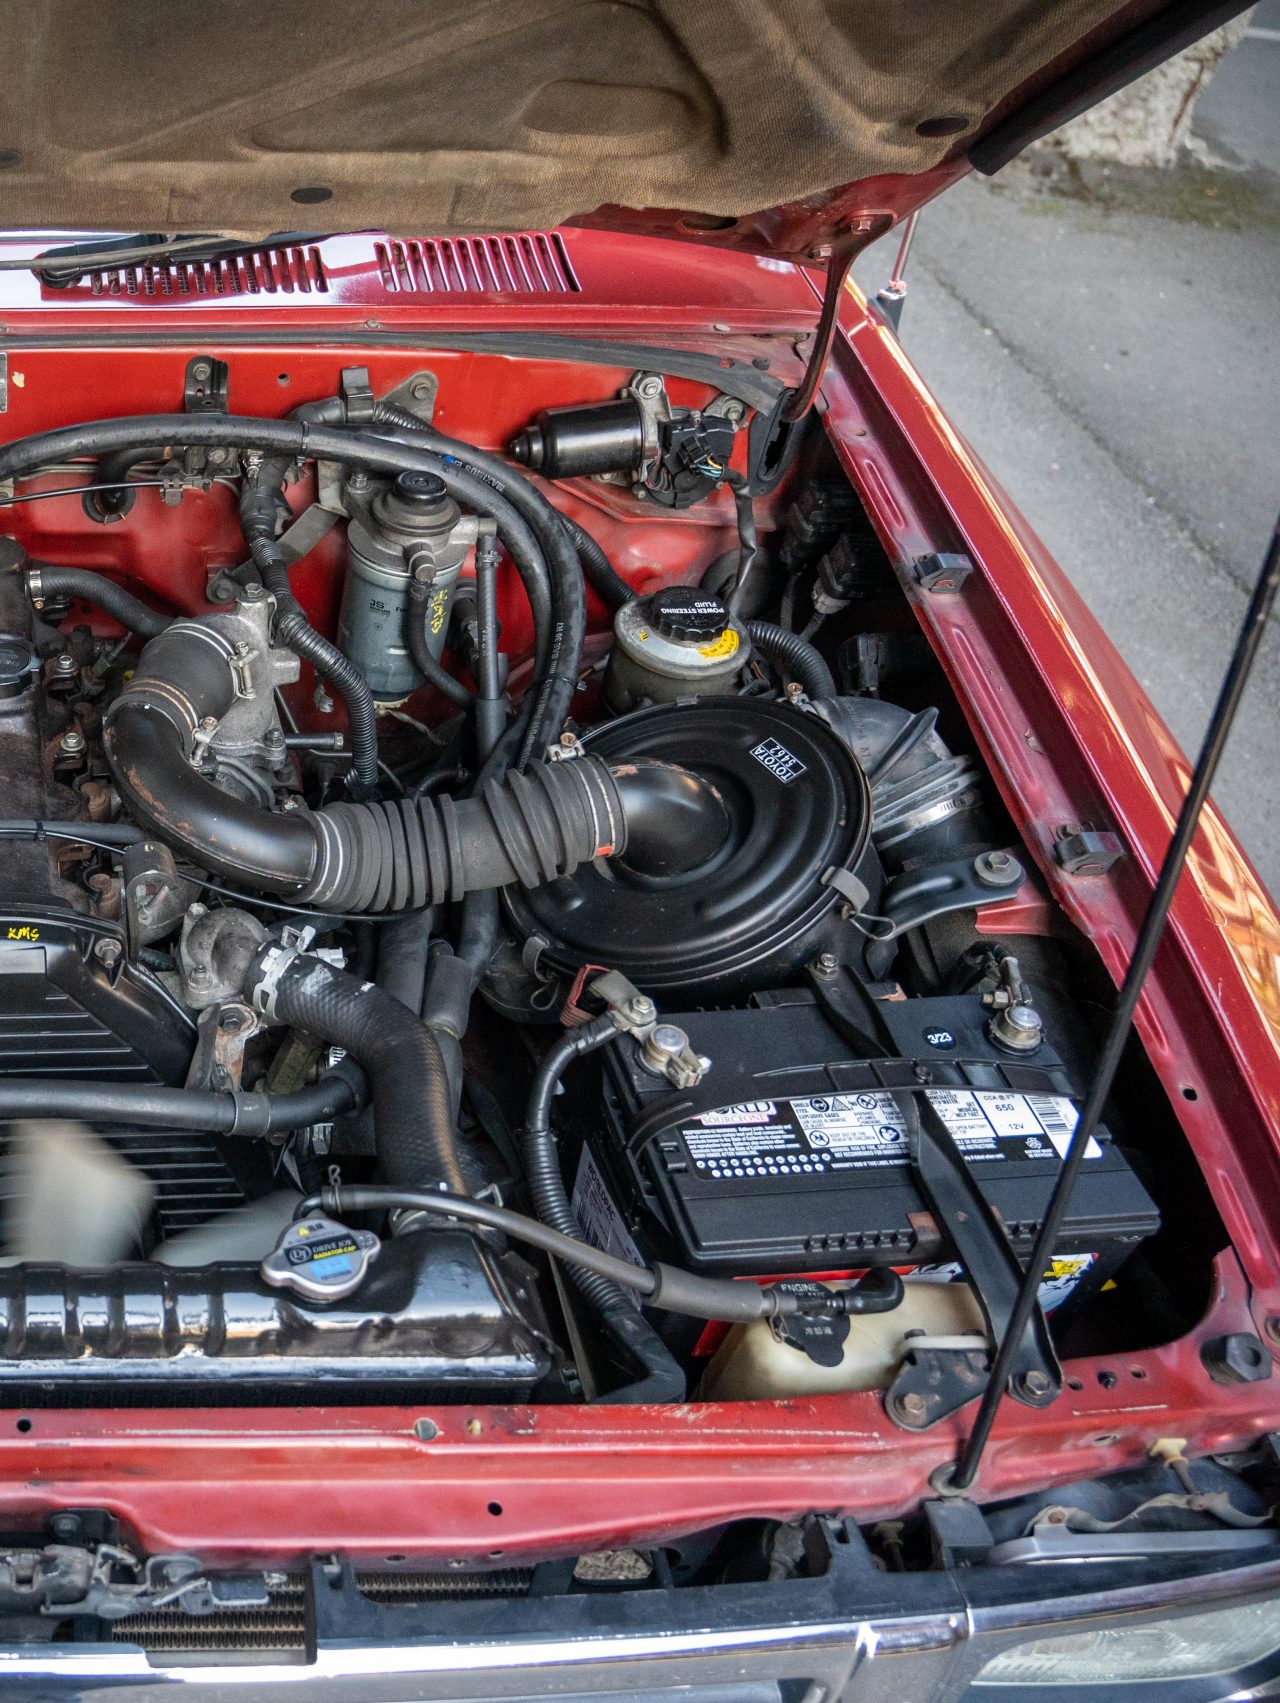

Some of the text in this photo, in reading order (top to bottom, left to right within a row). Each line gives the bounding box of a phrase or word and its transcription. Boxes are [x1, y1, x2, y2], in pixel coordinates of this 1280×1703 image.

[464, 464, 507, 492] MAXIMUS
[754, 746, 792, 781] TOYOTA
[769, 745, 796, 767] 5462
[7, 926, 40, 942] KMS
[927, 1032, 953, 1045] 3/23
[995, 1103, 1015, 1112] 650
[703, 1114, 767, 1125] SOURCEONE
[587, 1161, 617, 1222] WORLDPAC
[312, 1241, 337, 1253] DRIVE
[313, 1245, 358, 1260] RADIATOR CAP
[780, 1283, 819, 1294] ENGINE
